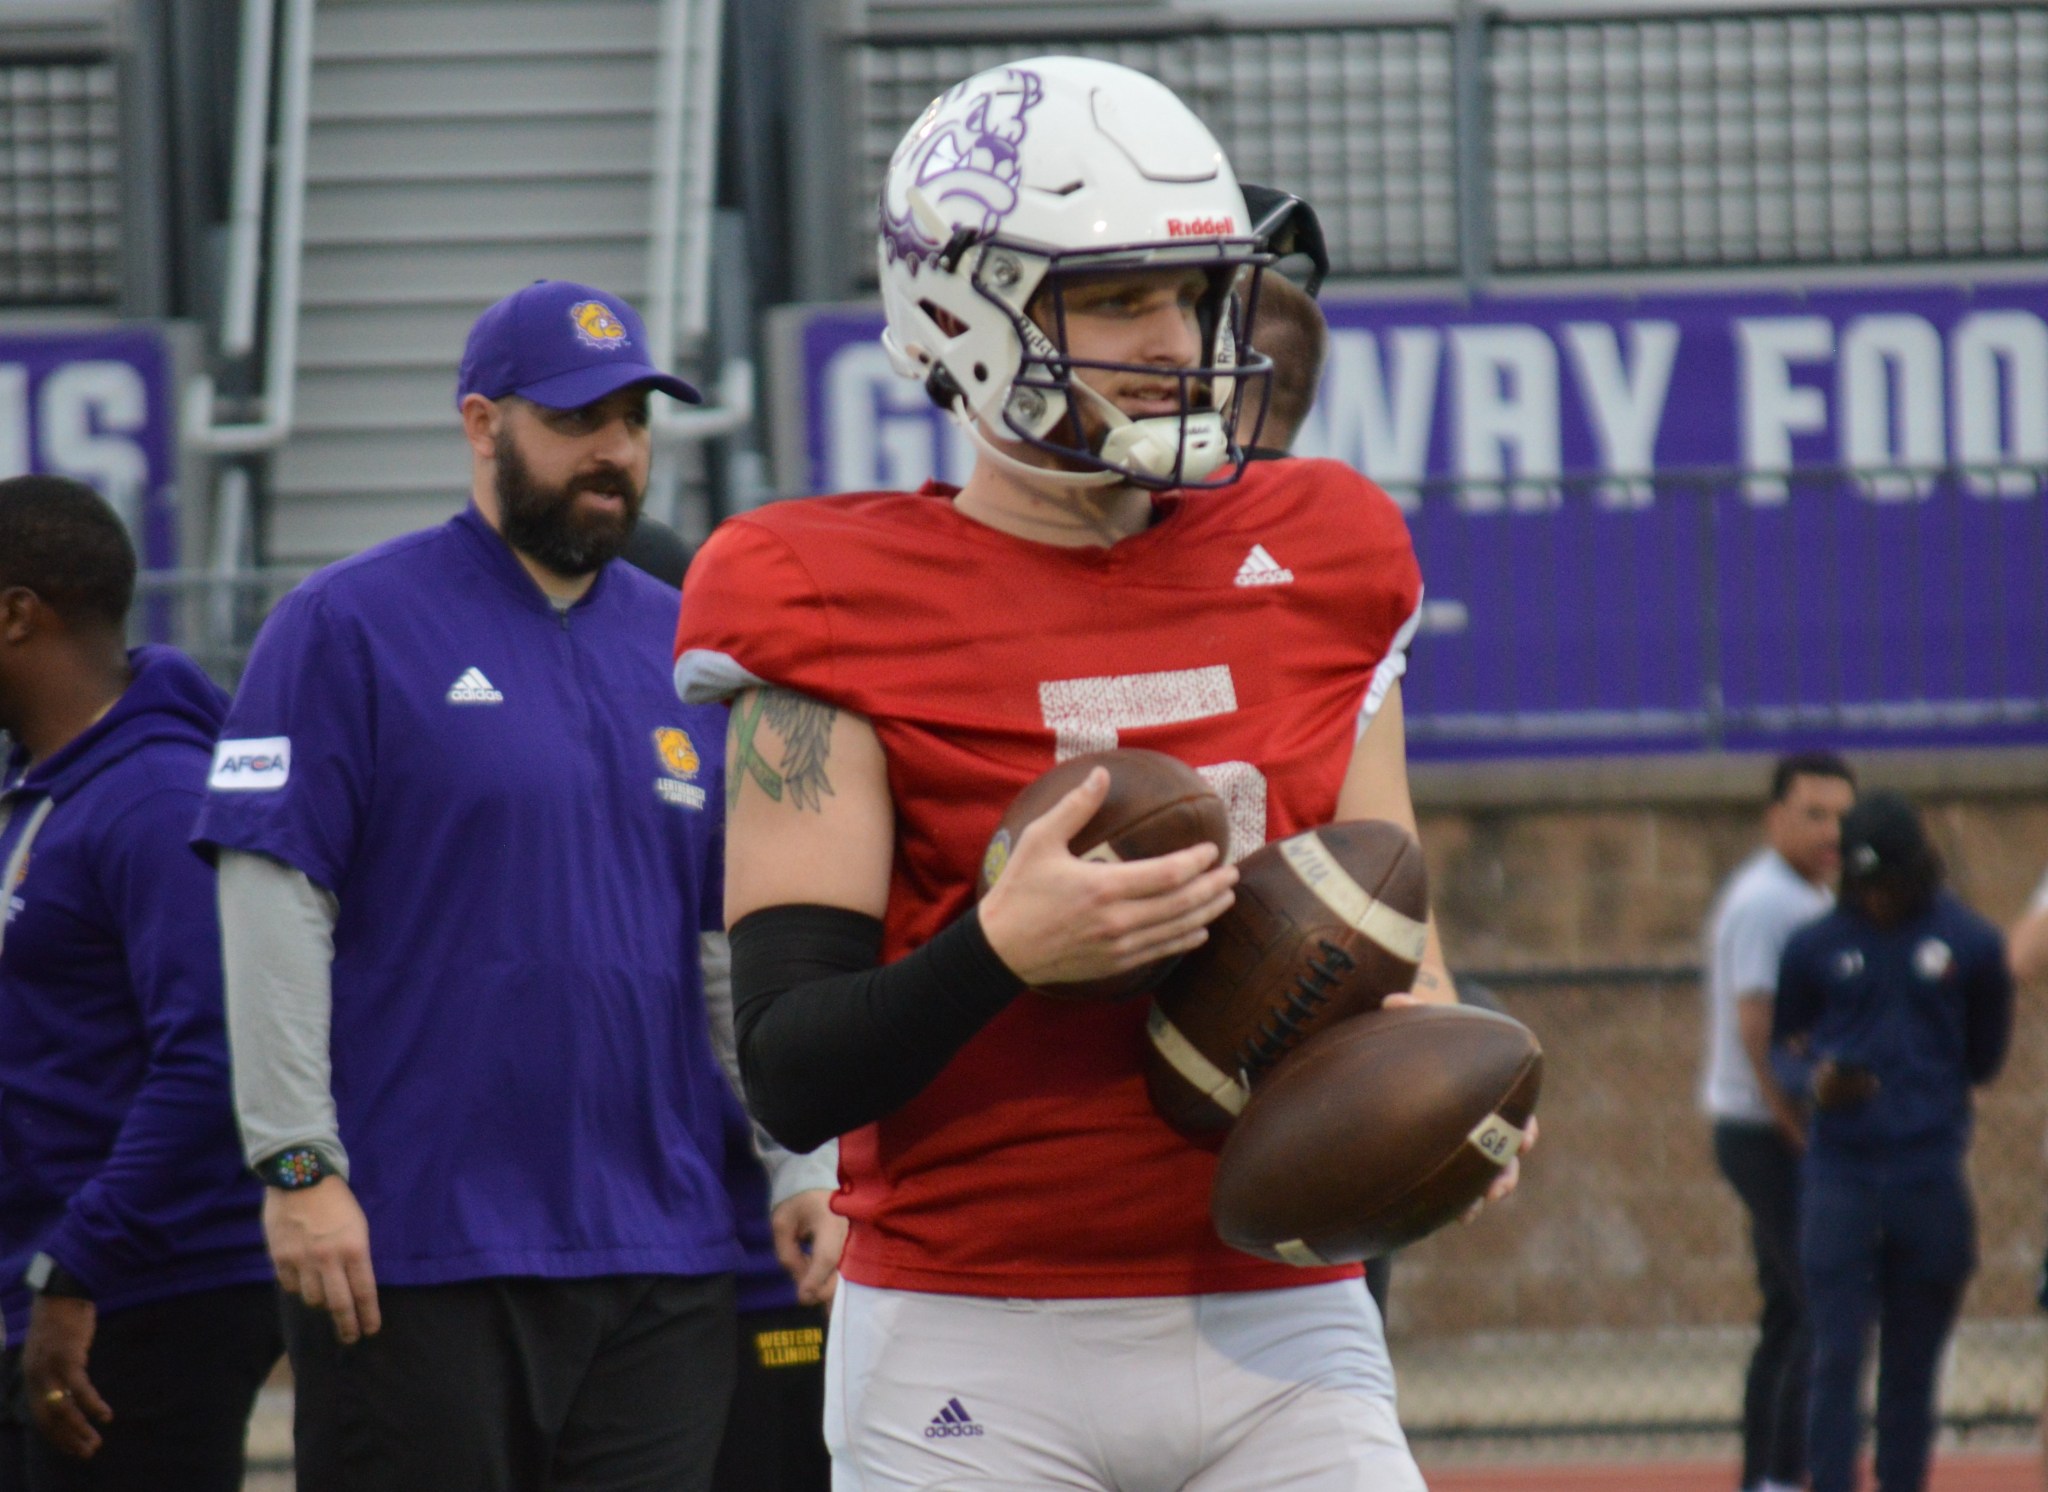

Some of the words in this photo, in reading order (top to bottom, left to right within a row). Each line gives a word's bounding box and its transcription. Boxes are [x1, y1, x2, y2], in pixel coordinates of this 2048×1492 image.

[1167, 215, 1234, 236] Riddell
[0, 360, 149, 550] S
[1235, 567, 1294, 587] adidas
[448, 688, 503, 702] adidas
[219, 753, 285, 773] AFCA
[757, 1327, 823, 1348] WESTERN
[762, 1345, 820, 1366] ILLINOIS
[924, 1422, 984, 1438] adidas
